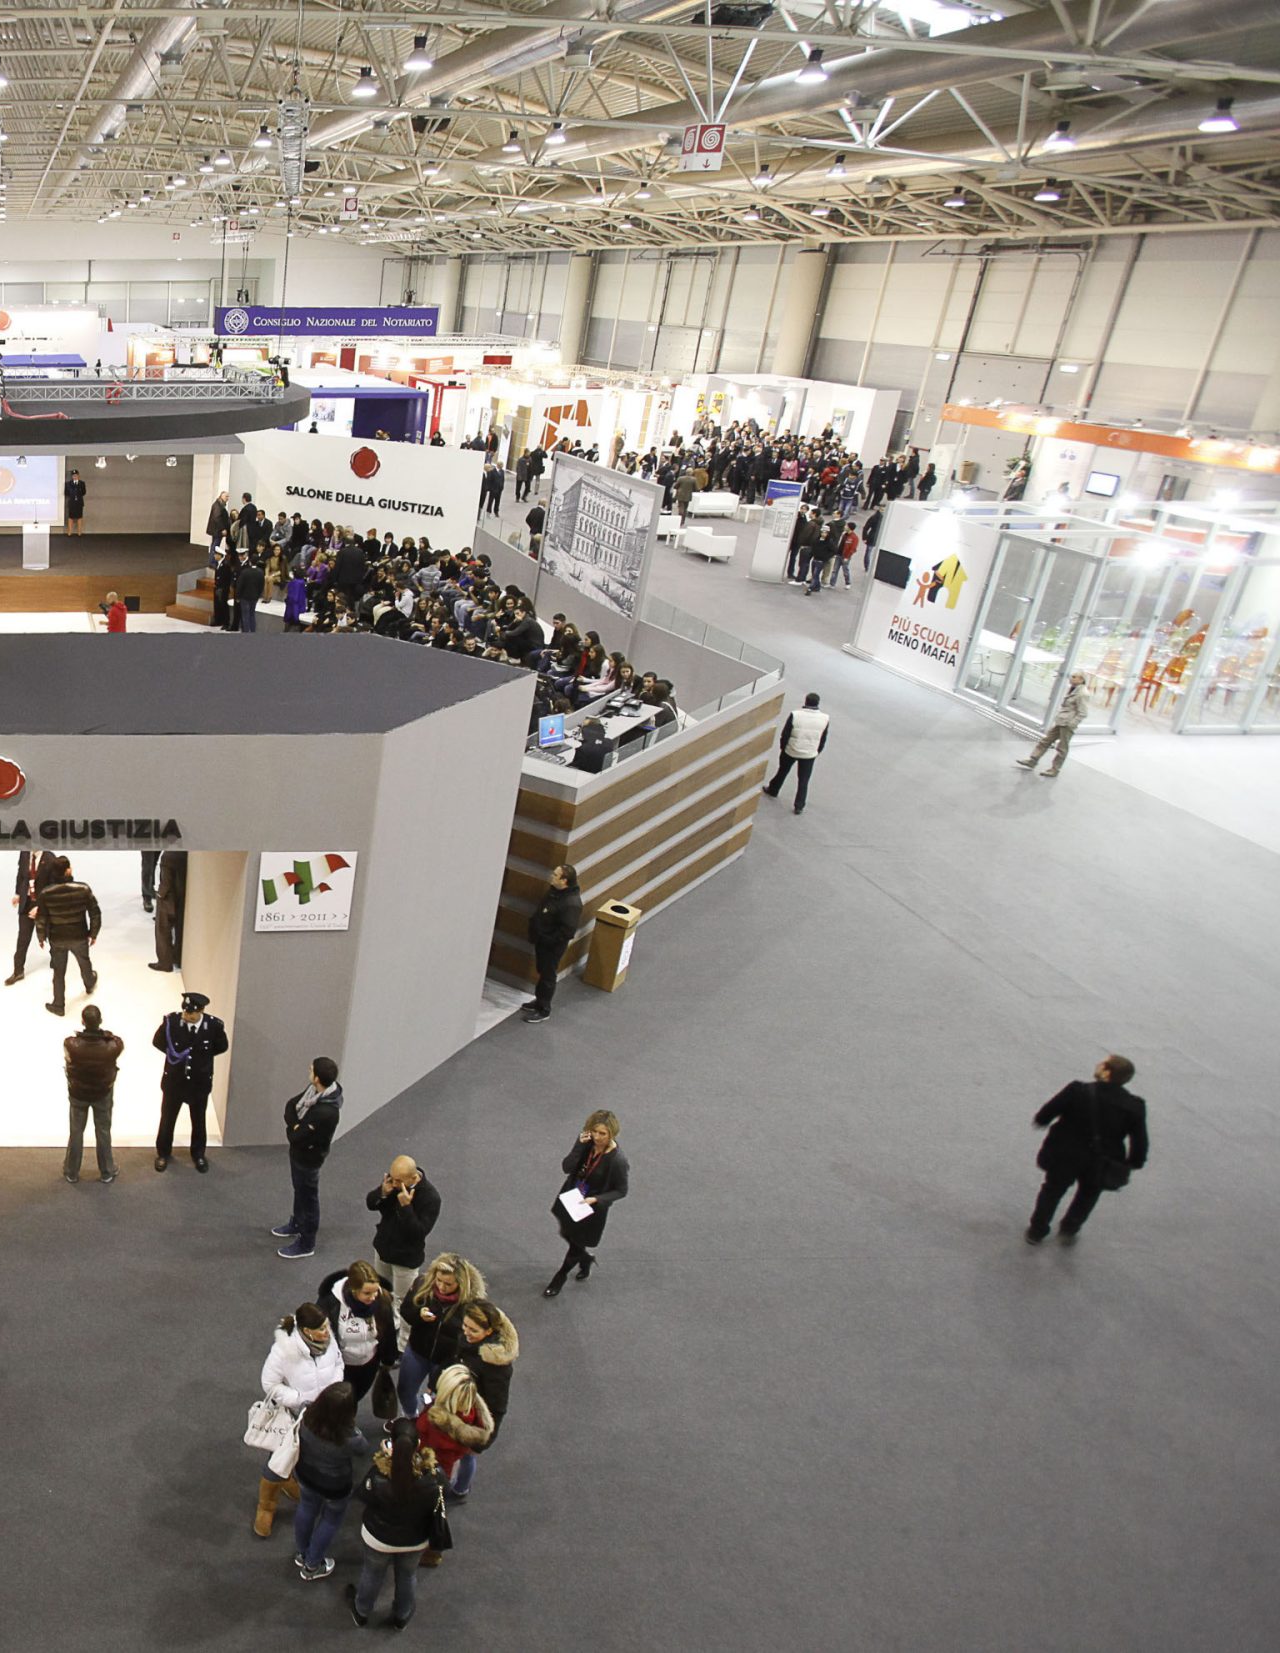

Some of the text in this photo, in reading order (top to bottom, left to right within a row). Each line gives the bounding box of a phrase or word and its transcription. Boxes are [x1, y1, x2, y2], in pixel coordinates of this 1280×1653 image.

[285, 485, 444, 517] SALONE DELLA GIUSTIZIA
[887, 628, 956, 667] MENO MAFIA
[891, 614, 960, 653] PIÙ SCUOLA
[39, 818, 182, 842] GIUSTIZIA
[260, 911, 326, 922] 1861 2011
